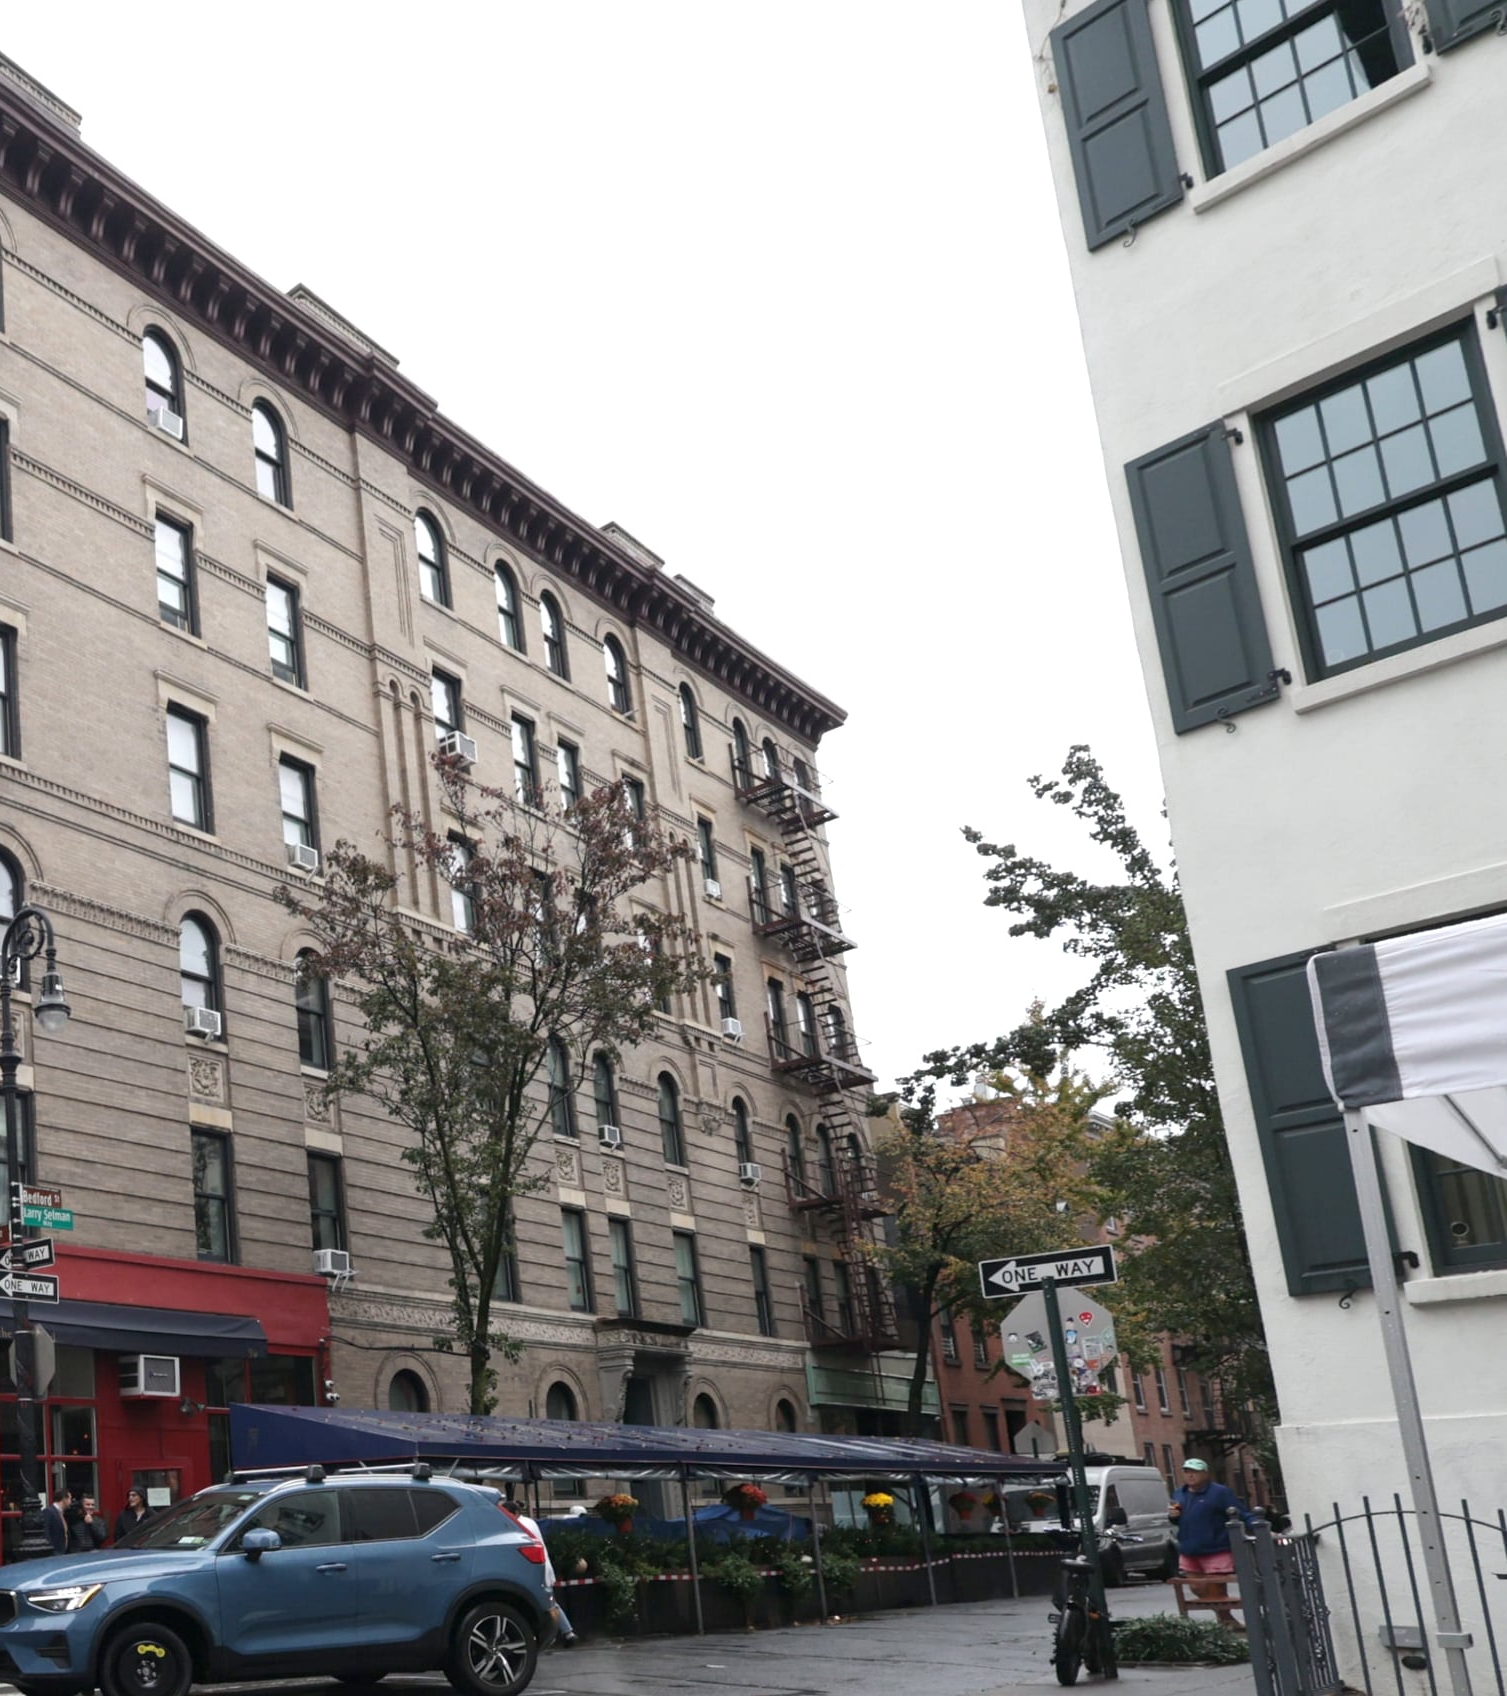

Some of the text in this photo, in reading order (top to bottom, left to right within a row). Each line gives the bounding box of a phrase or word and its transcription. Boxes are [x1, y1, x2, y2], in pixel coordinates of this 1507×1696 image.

[23, 1190, 52, 1206] Bedford
[23, 1207, 71, 1222] Larry Selman
[28, 1247, 46, 1261] WAY
[1001, 1259, 1094, 1284] ONE WAY
[4, 1279, 51, 1294] ONE WAY
